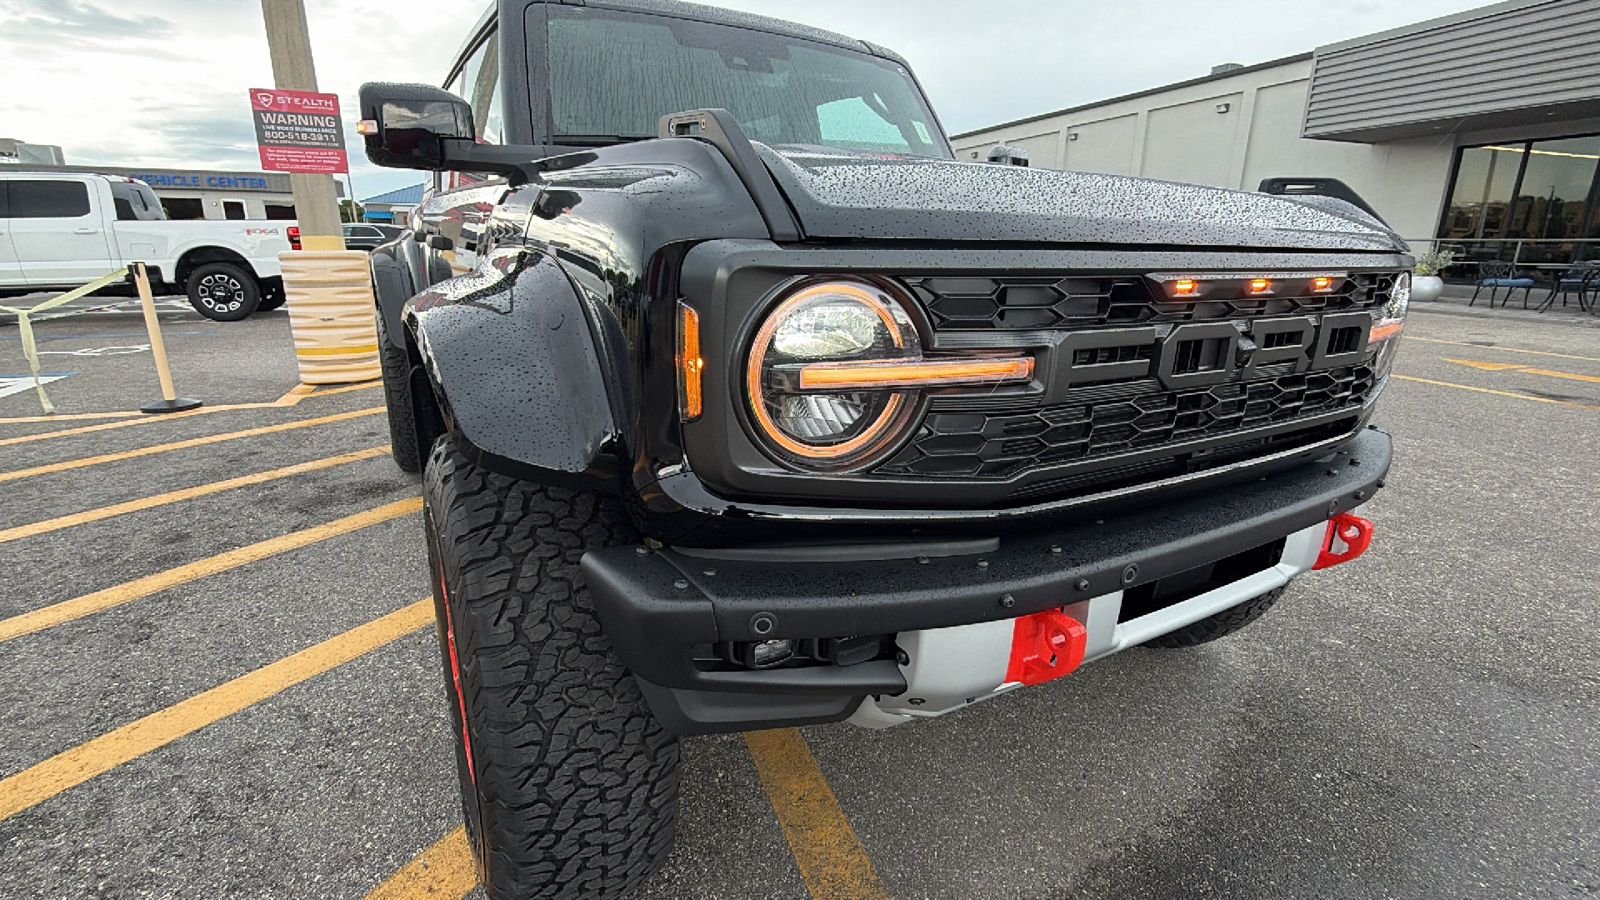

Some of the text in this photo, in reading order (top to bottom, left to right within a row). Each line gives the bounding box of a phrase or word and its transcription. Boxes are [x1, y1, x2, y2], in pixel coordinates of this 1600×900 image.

[277, 96, 333, 107] STEALTH
[260, 113, 336, 127] WARNING
[264, 131, 336, 142] 800-518-3911
[206, 175, 267, 188] CENTER
[246, 227, 279, 235] FX4
[1044, 312, 1373, 402] FORD
